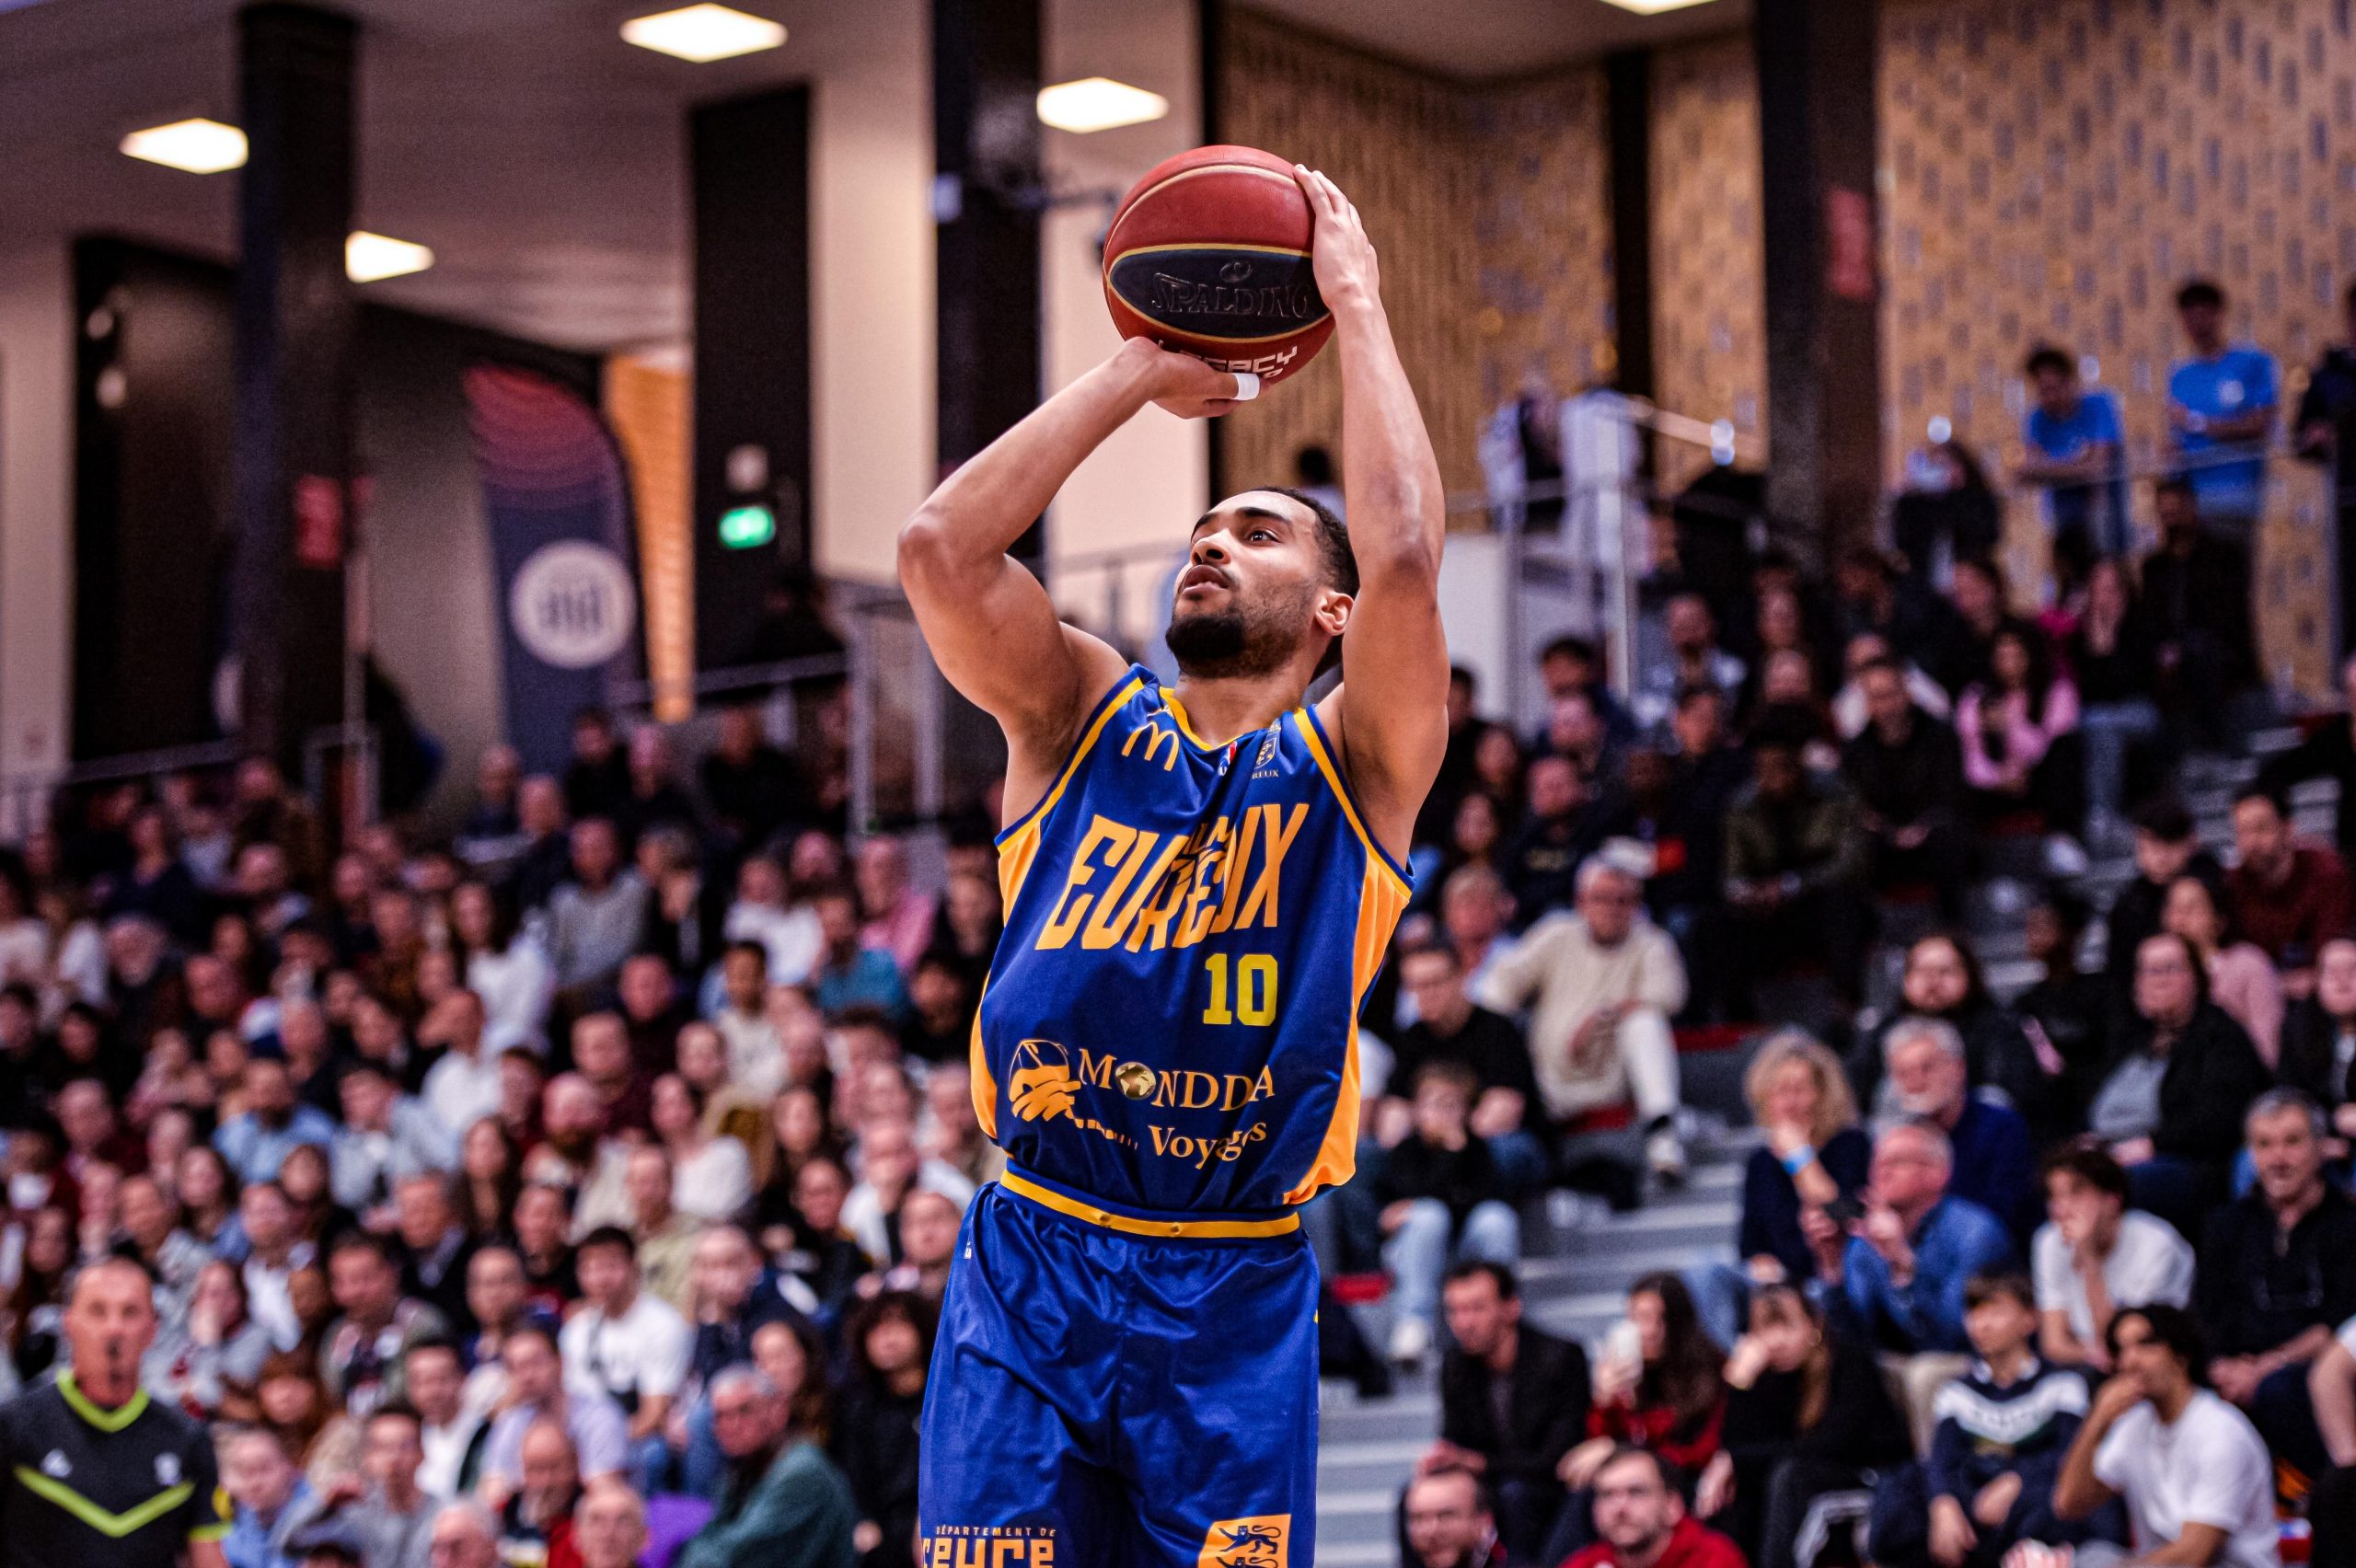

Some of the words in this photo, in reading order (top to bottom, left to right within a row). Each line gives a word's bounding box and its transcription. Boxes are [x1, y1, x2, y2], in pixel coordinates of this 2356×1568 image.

[1151, 272, 1312, 318] SPALDING
[1203, 952, 1278, 1026] 10
[936, 1524, 1032, 1538] DÉPARTEMENT
[1040, 1528, 1057, 1538] DE
